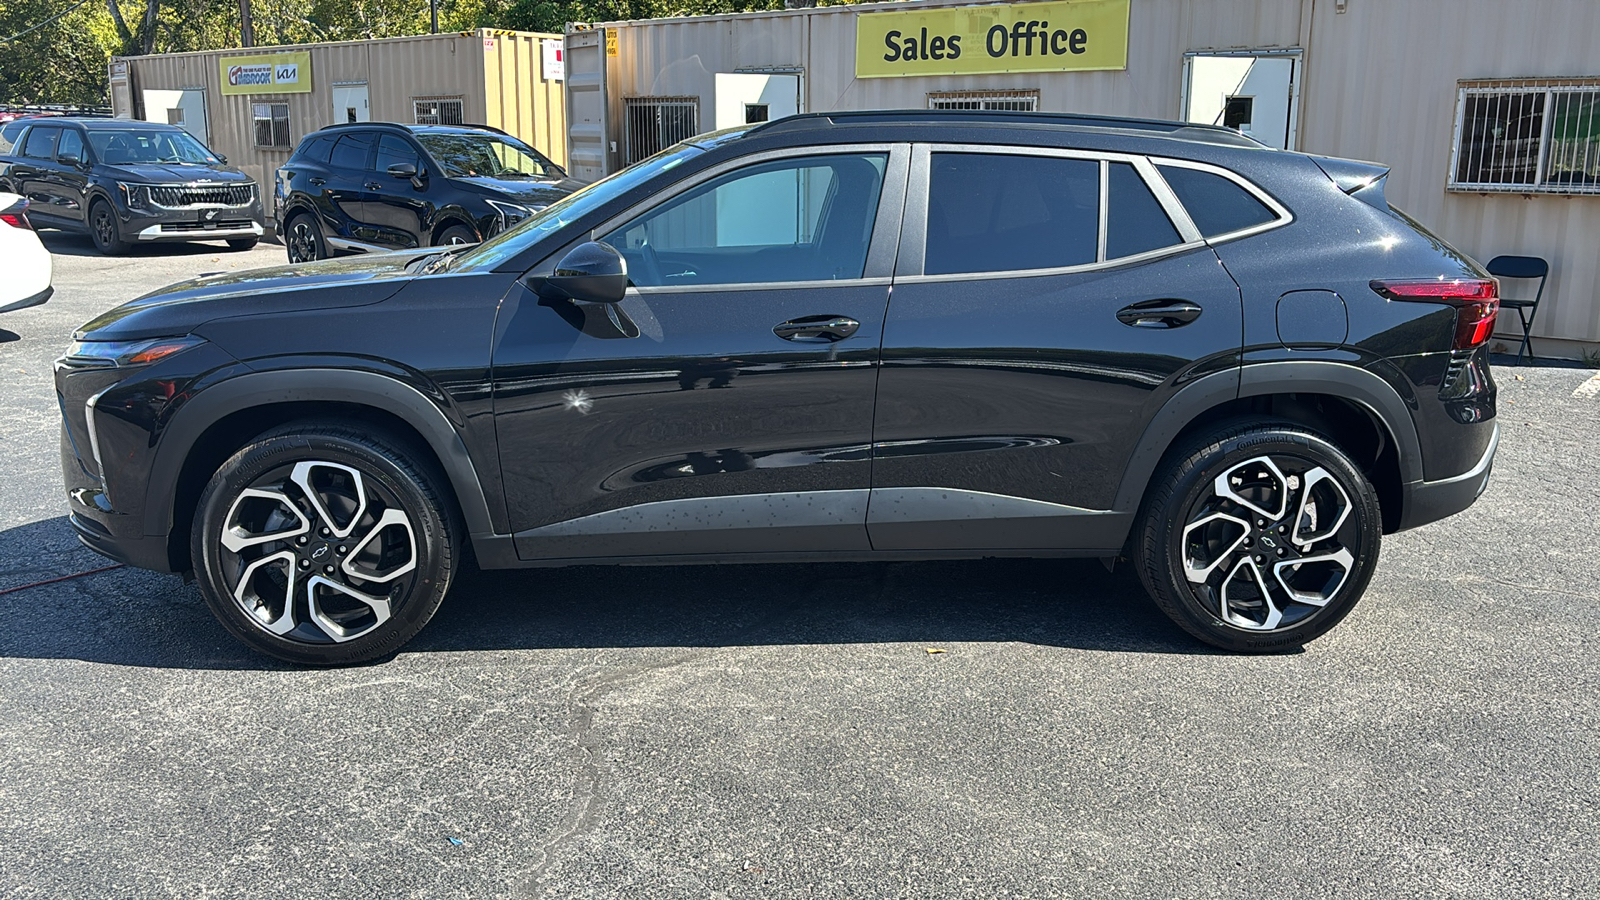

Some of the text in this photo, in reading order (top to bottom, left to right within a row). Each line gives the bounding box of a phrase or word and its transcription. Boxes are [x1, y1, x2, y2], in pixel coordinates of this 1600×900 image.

[883, 20, 1088, 62] Sales Office
[1236, 435, 1288, 451] Continental
